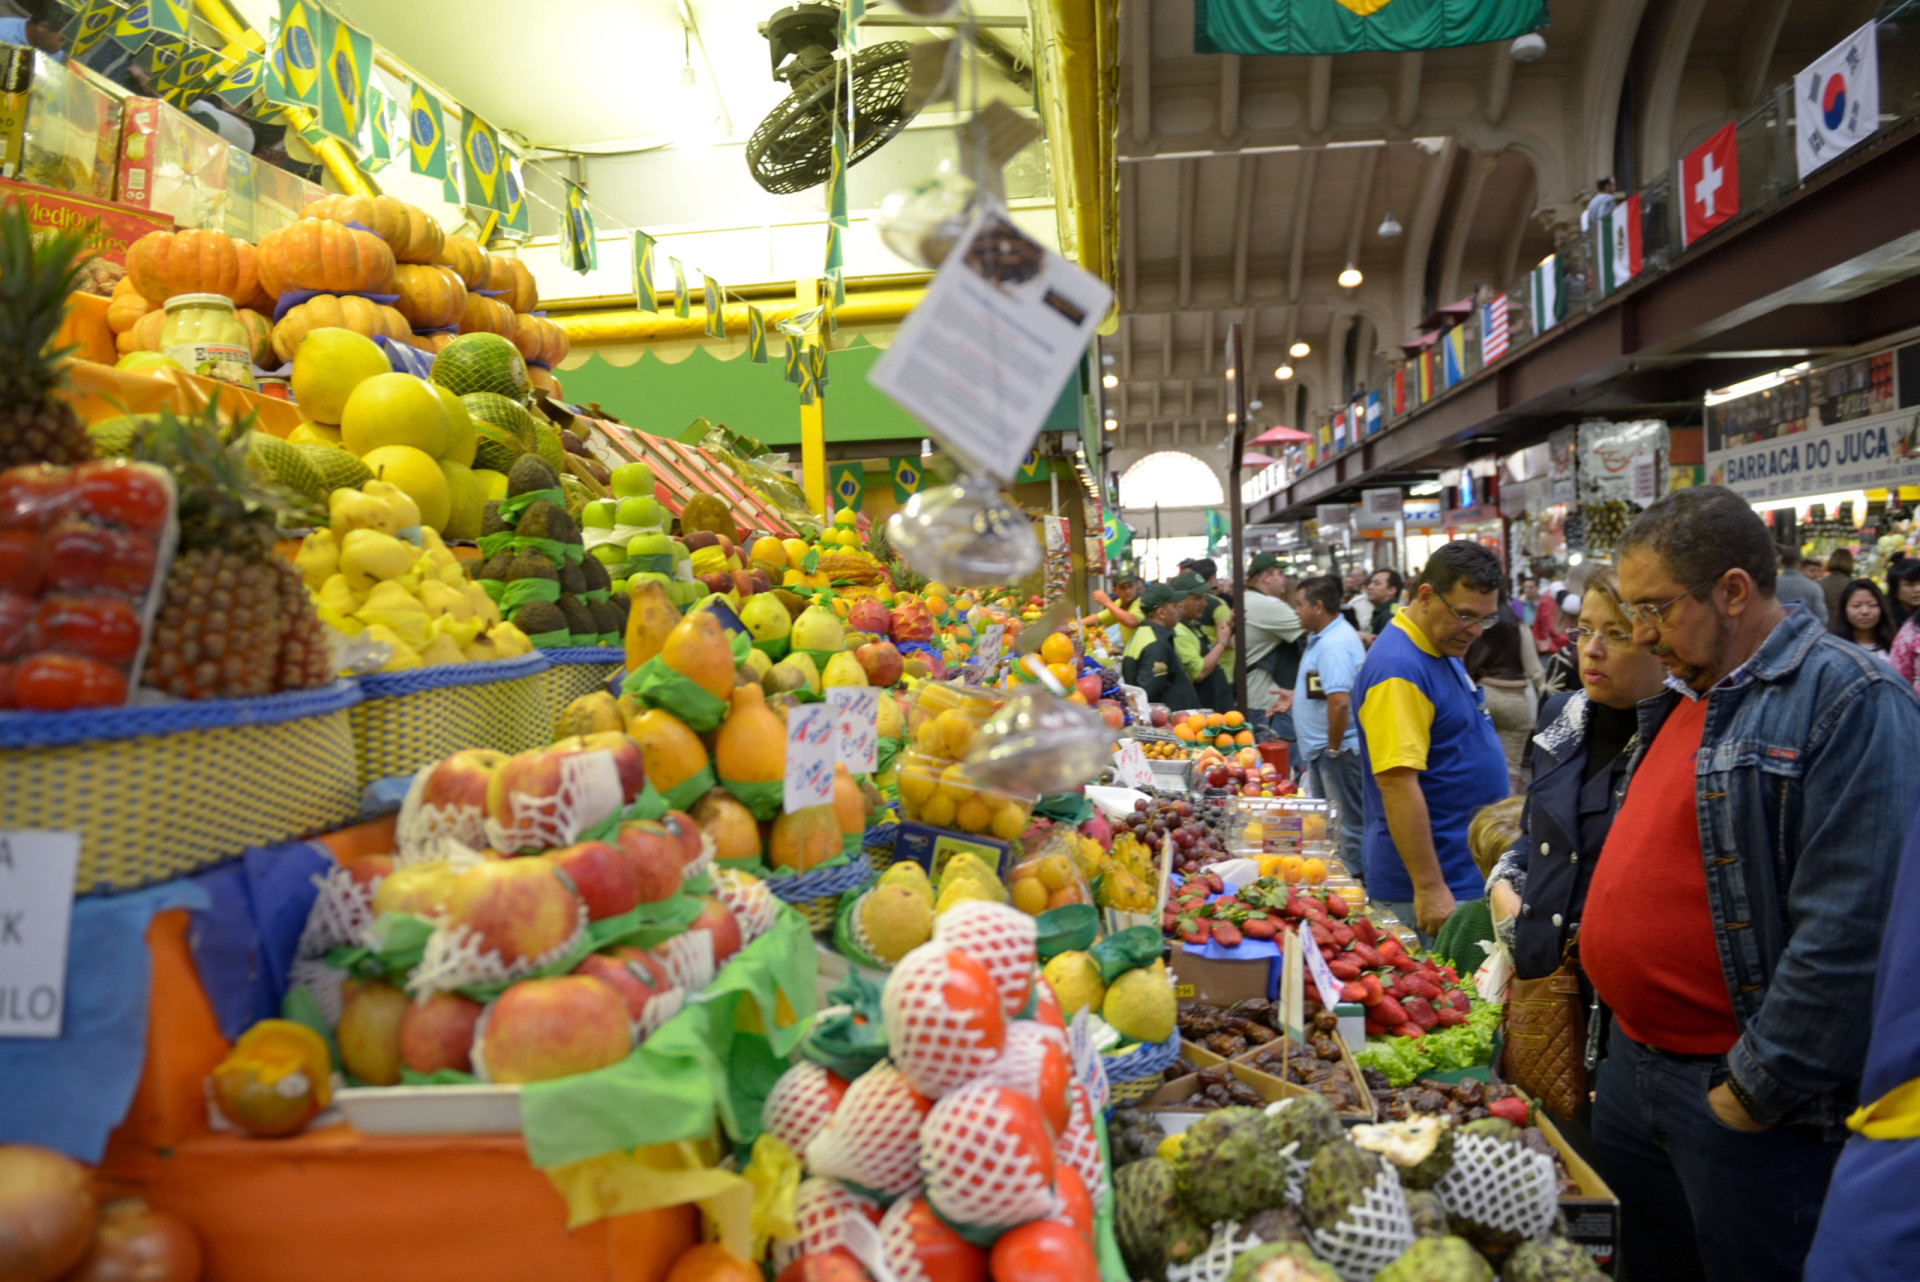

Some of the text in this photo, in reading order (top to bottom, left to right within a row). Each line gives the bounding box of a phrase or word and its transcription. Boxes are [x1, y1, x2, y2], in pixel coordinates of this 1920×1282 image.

[86, 232, 129, 254] ates
[1727, 446, 1800, 484] BARRACA
[1806, 439, 1831, 471] DO
[1836, 427, 1890, 465] JUCA
[0, 911, 24, 945] K
[0, 983, 57, 1022] ILO
